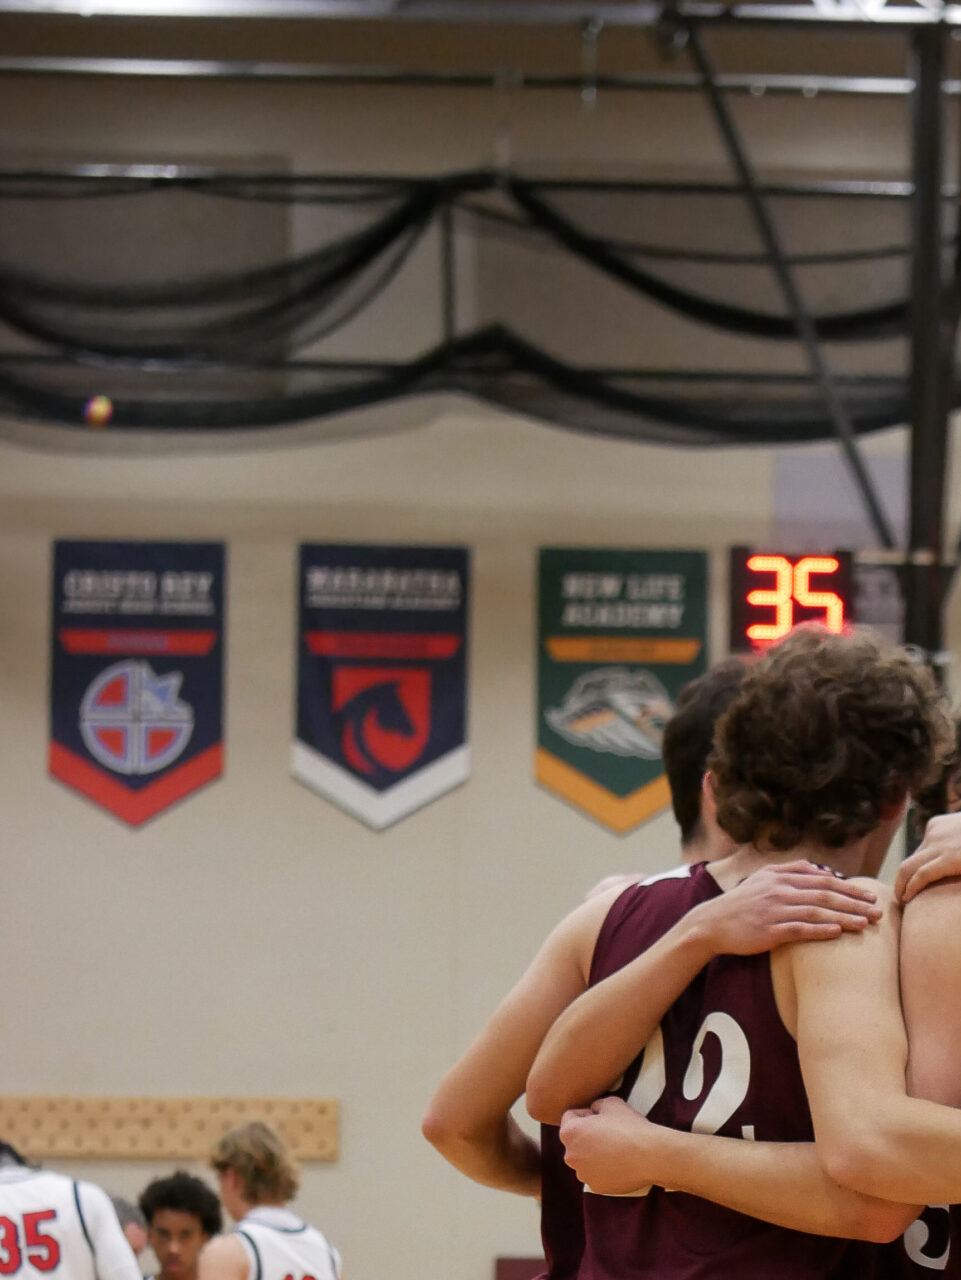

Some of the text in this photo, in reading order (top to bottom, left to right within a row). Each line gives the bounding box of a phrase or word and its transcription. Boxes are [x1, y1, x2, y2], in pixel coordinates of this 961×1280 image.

[562, 574, 685, 600] NEW LIFE
[747, 556, 843, 639] 35
[562, 602, 684, 628] ACADEMY
[0, 1209, 60, 1275] 35
